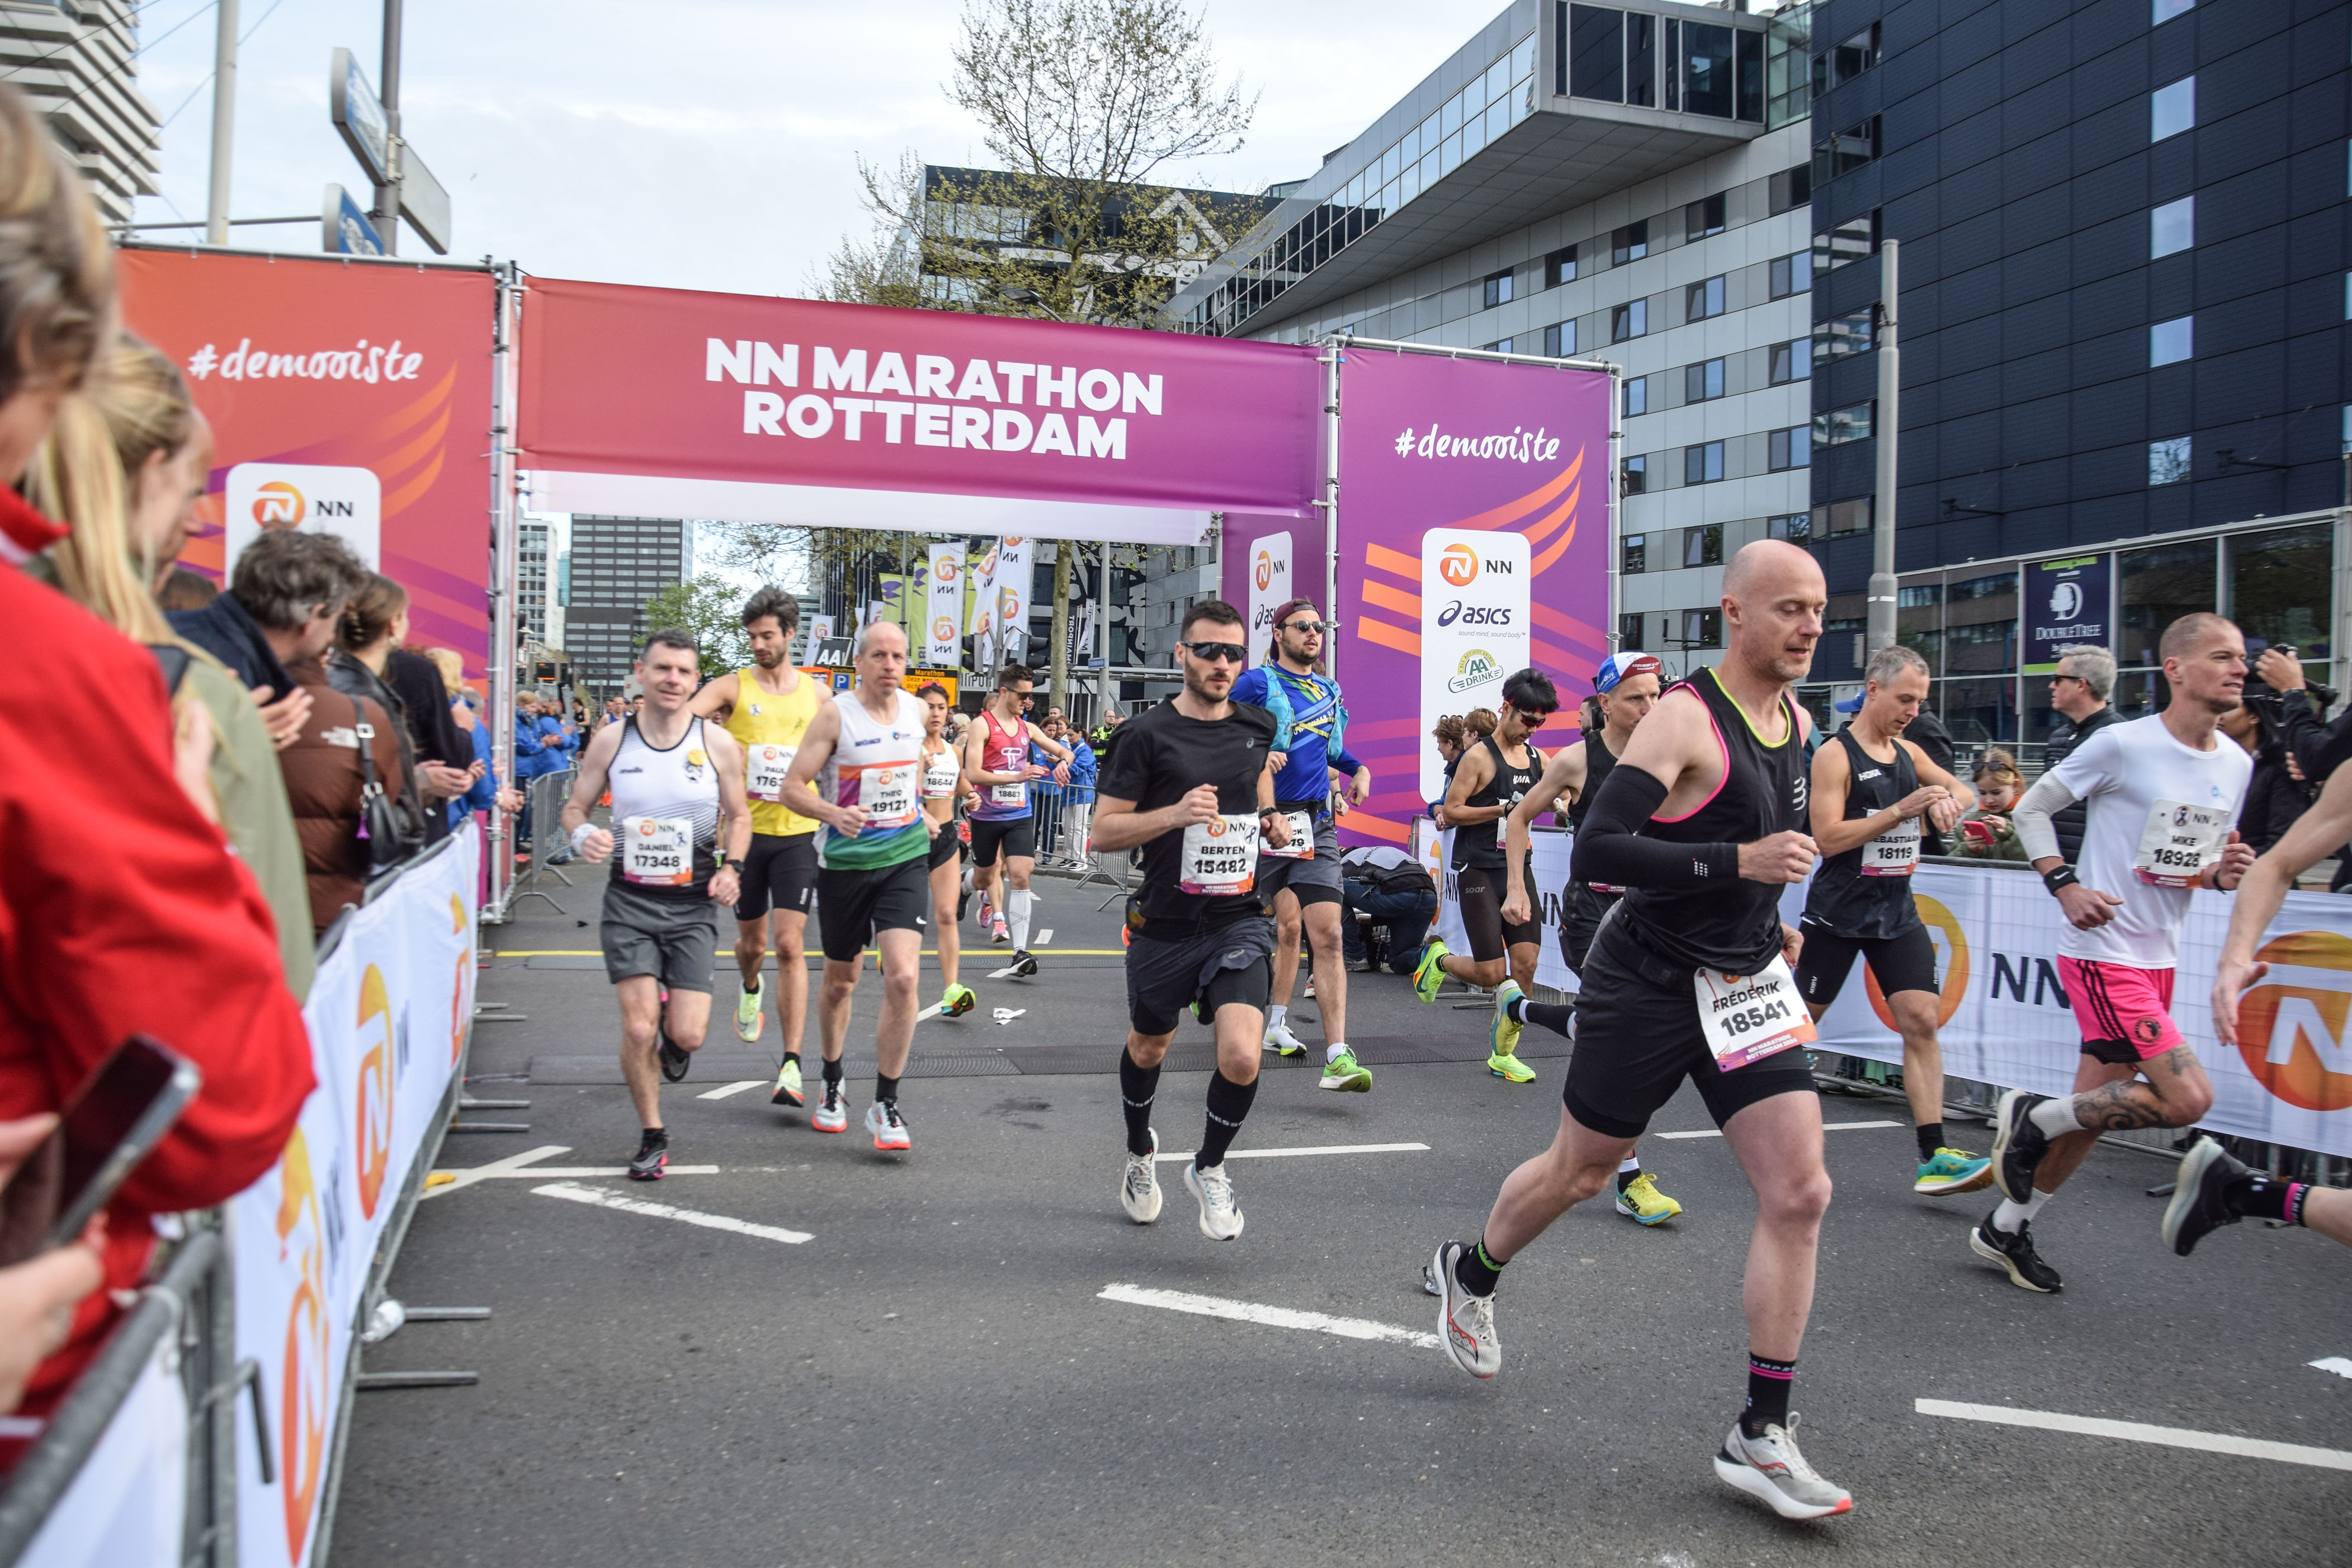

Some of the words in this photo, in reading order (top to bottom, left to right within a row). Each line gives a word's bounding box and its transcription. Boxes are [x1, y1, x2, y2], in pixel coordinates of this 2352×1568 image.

[188, 338, 424, 384] #demooiste
[706, 338, 799, 388] NN
[813, 346, 1164, 417] MARATHON
[743, 390, 1127, 460] ROTTERDAM
[1395, 423, 1561, 463] #demooiste
[315, 499, 353, 518] NN
[1273, 559, 1284, 575] NN
[1485, 559, 1513, 574] NN
[1462, 607, 1512, 625] asics
[1469, 659, 1489, 676] AA
[1466, 671, 1494, 686] DRINK
[871, 799, 908, 813] 19121
[1229, 823, 1246, 833] NN
[1201, 846, 1245, 856] BERTEN
[1877, 847, 1912, 859] 18119
[634, 855, 680, 867] 17348
[1194, 858, 1246, 874] 15482
[1465, 885, 1485, 894] soar
[1991, 952, 2071, 1009] NN
[1712, 980, 1780, 1013] FRÉDÉRIK
[1721, 999, 1791, 1037] 18541
[1757, 1033, 1792, 1051] MARATHON
[1745, 1042, 1784, 1061] ROTTERDAM
